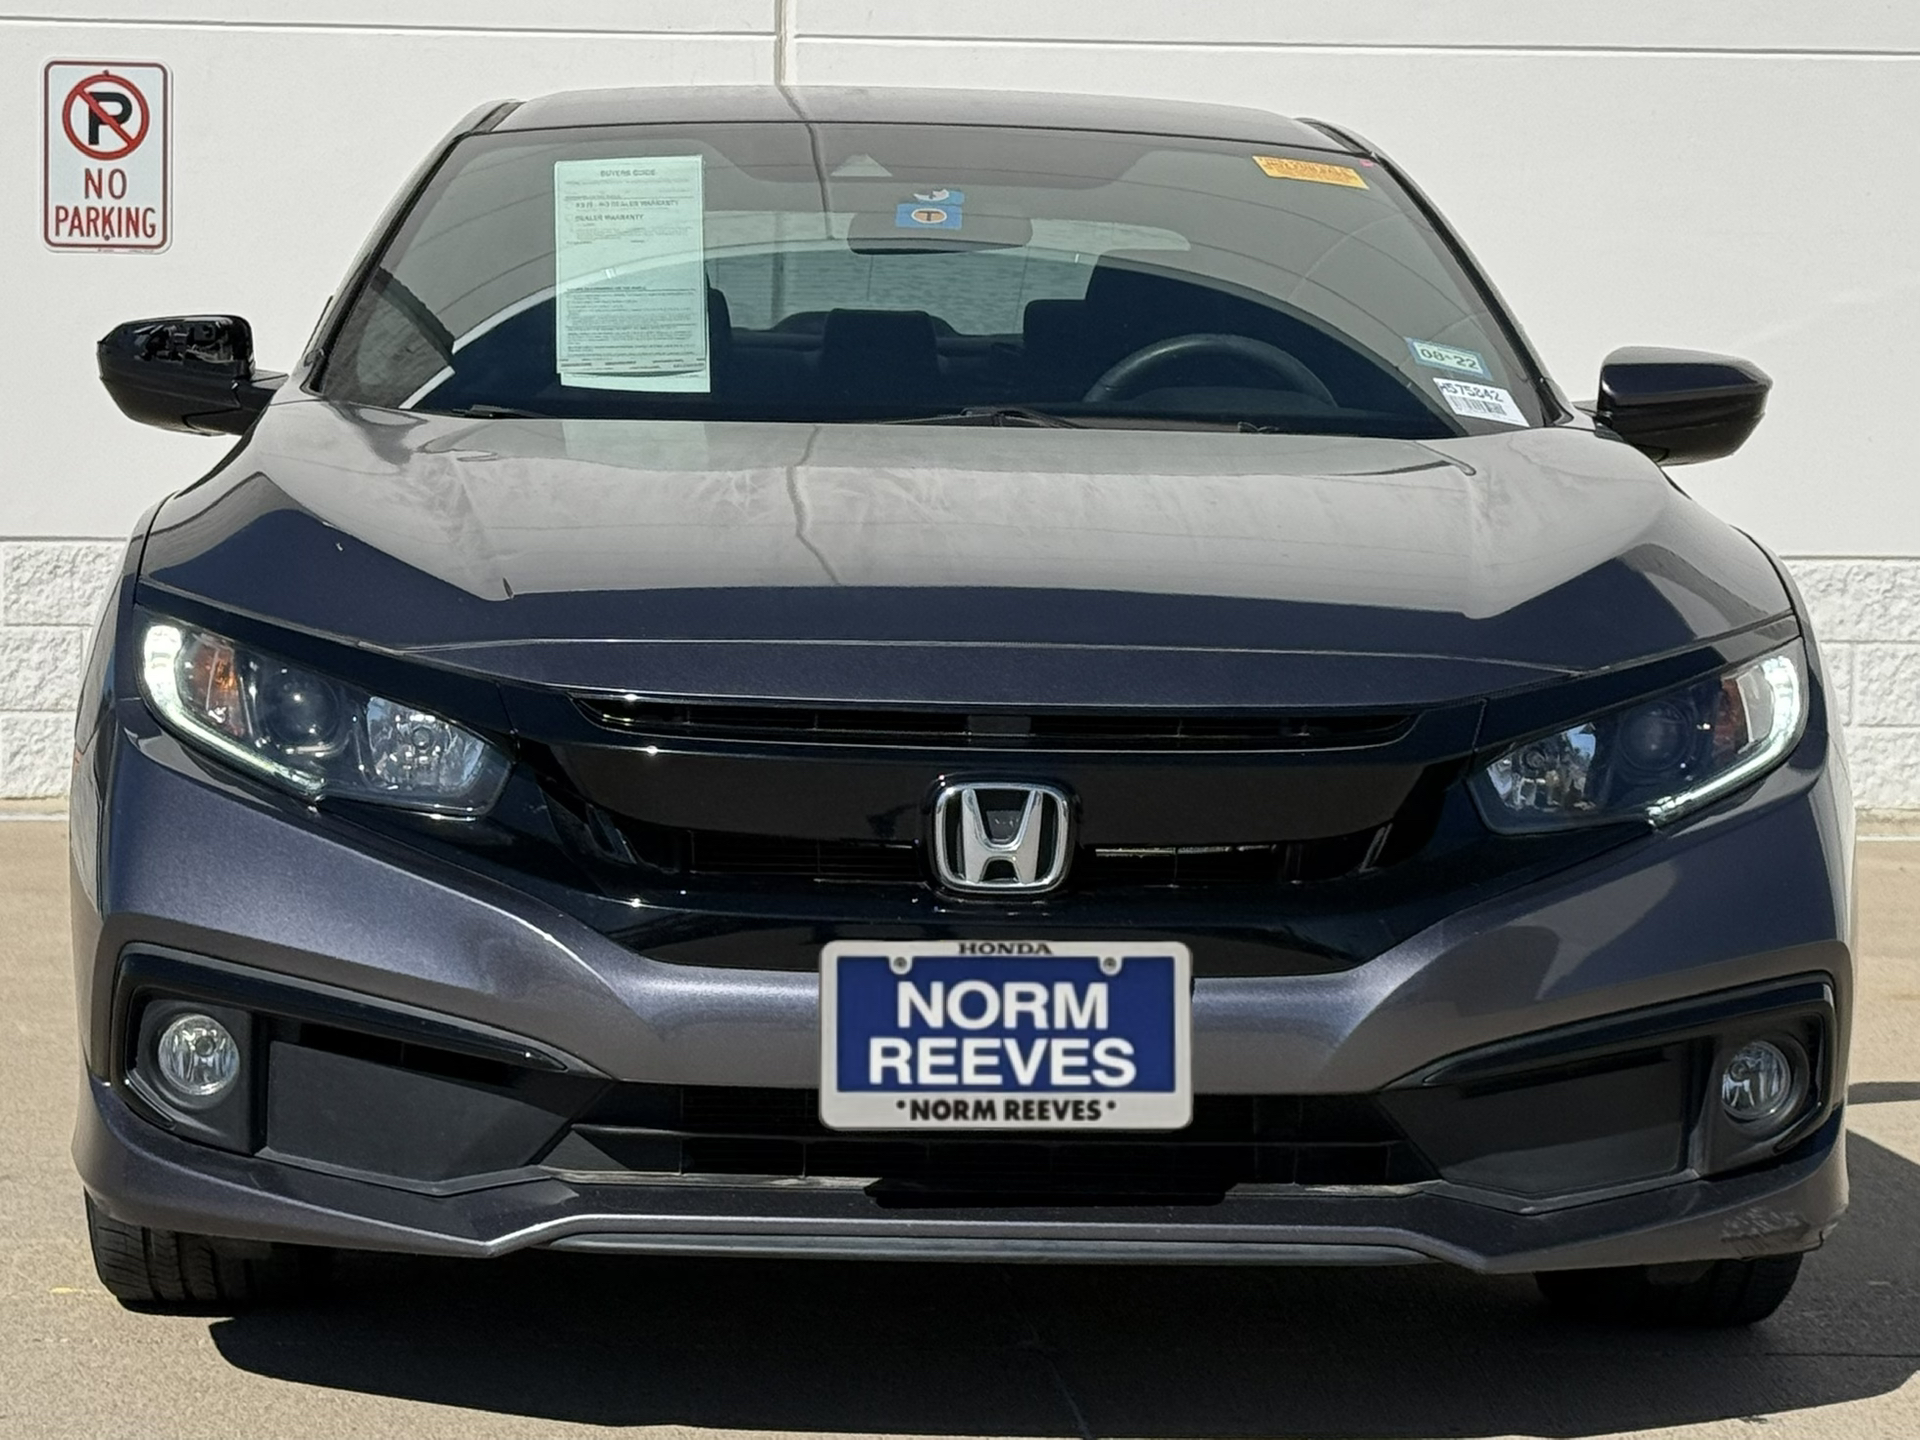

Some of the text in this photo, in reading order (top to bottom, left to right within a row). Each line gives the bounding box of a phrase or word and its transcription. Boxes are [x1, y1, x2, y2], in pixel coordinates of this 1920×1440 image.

[88, 91, 133, 146] P
[84, 167, 127, 200] NO
[54, 205, 157, 239] PARKING
[1419, 348, 1480, 370] 08-22
[958, 942, 1053, 956] HONDA
[896, 979, 1109, 1030] NORM
[869, 1036, 1137, 1088] REEVES
[909, 1098, 1103, 1122] NORM REEVES
